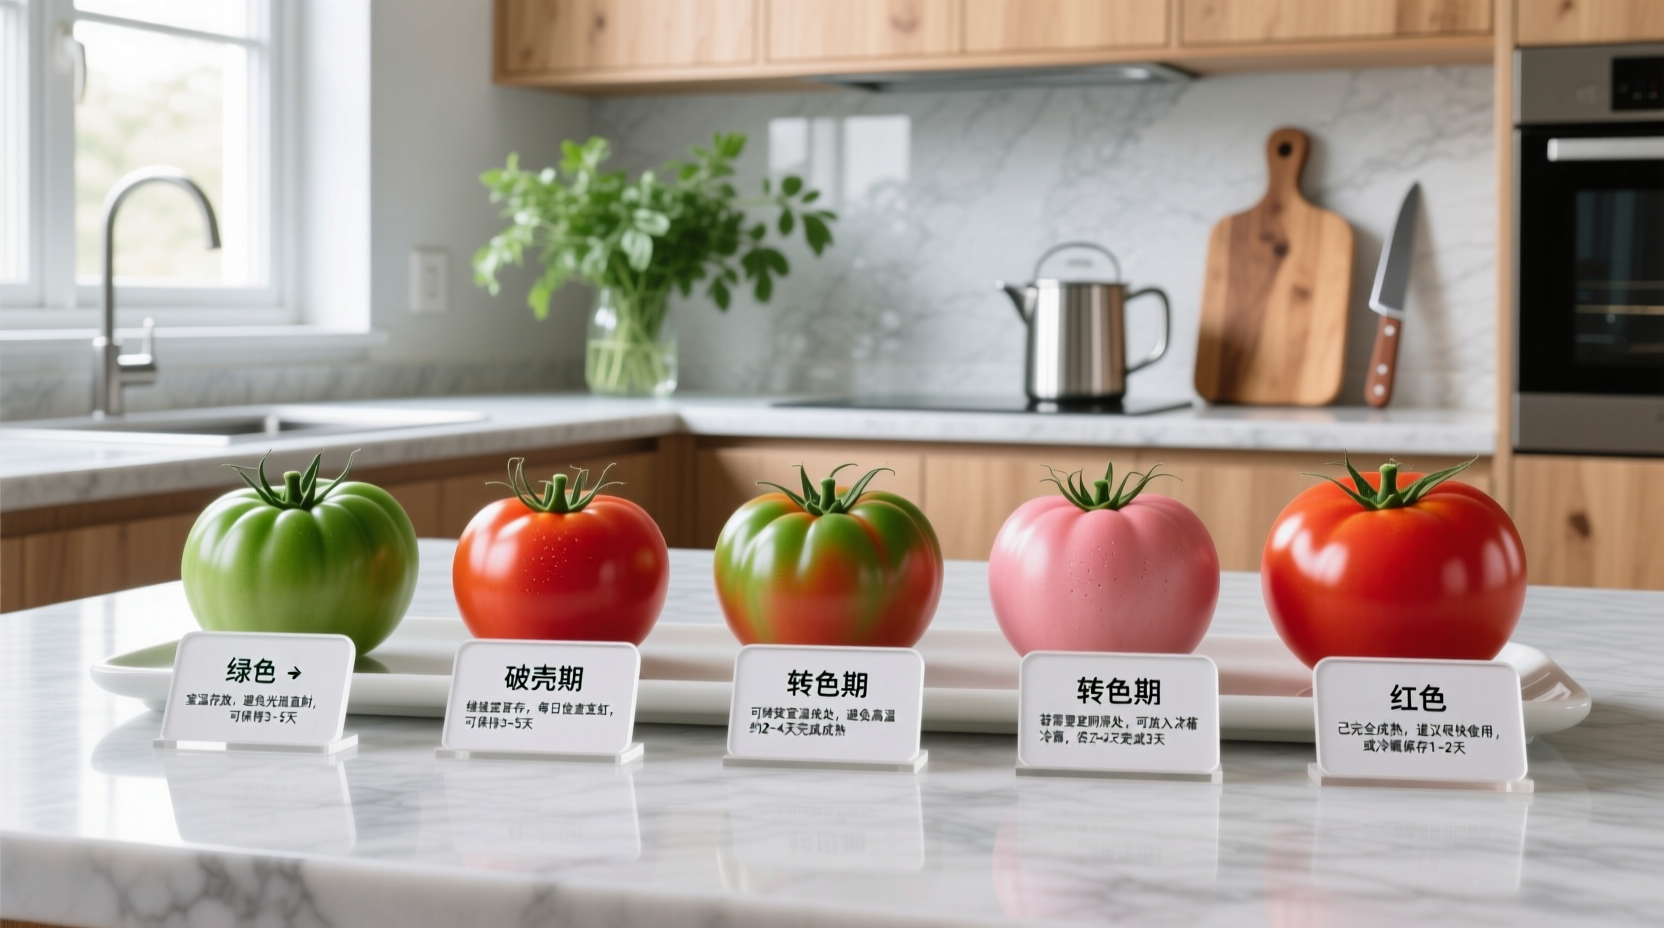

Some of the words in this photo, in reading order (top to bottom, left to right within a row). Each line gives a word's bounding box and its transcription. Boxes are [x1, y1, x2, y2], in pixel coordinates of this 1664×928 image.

[225, 657, 276, 684] 绿色
[504, 664, 584, 692] 破壳期
[786, 669, 868, 699] 转色期
[1076, 676, 1161, 705] 转色期
[1390, 684, 1447, 712] 红色
